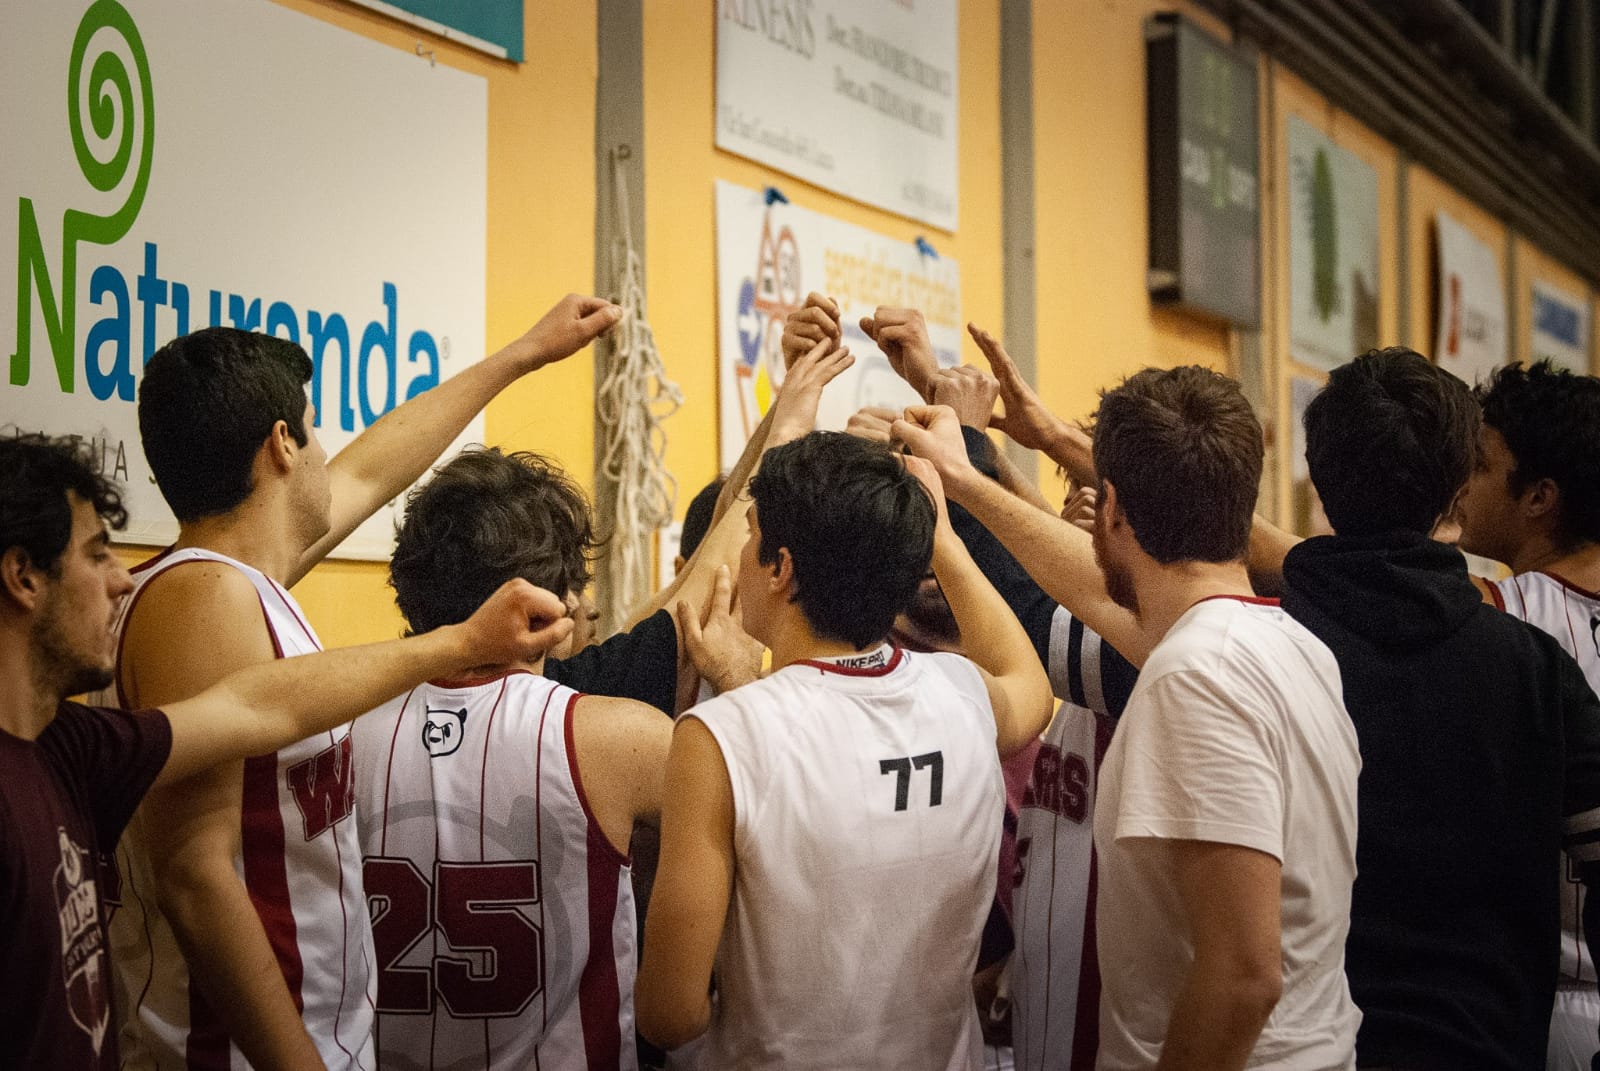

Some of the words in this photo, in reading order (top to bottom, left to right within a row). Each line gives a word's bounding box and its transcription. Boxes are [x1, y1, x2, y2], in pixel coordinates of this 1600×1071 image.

[836, 657, 867, 669] NIKE
[286, 733, 354, 842] W
[879, 751, 944, 812] 77
[362, 856, 545, 1019] 25
